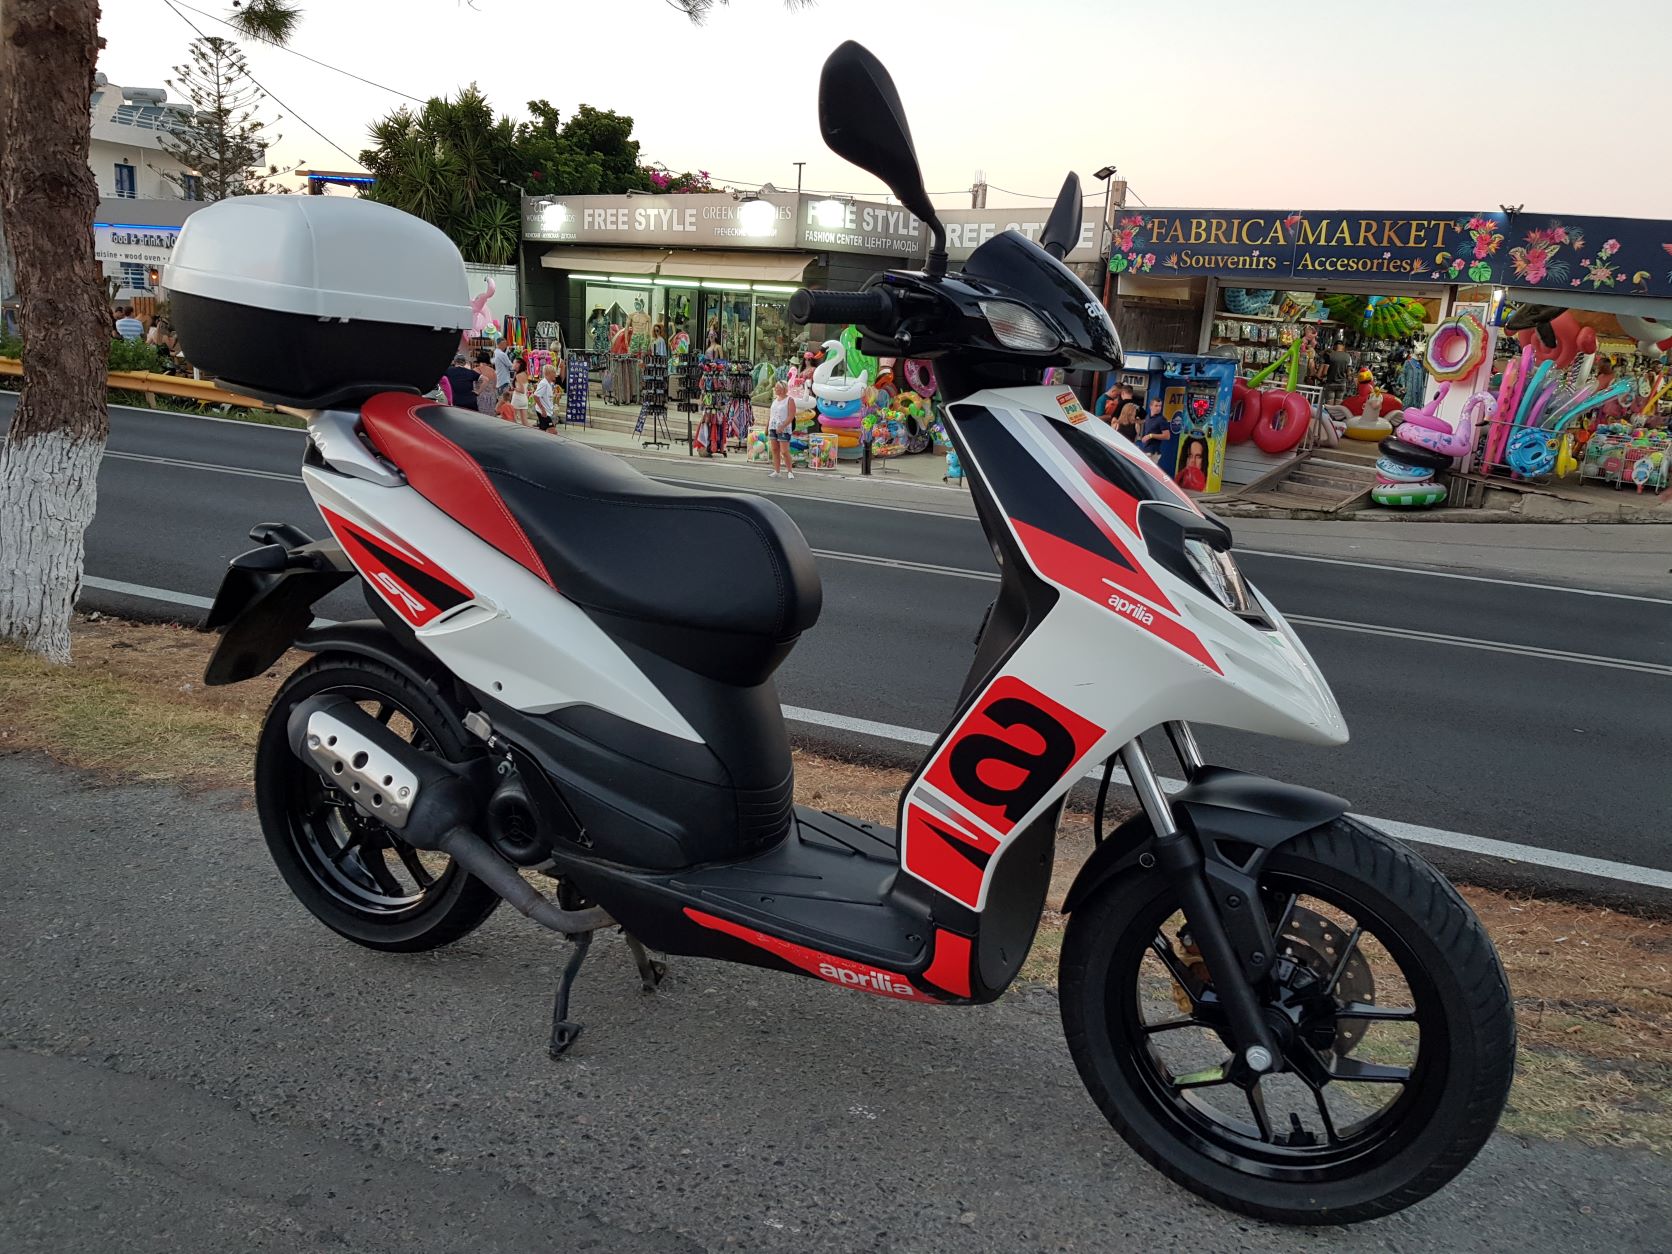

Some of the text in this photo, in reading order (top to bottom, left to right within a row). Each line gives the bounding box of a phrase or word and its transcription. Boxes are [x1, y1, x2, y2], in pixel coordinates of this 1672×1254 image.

[583, 208, 697, 231] FREE STYLE
[702, 206, 734, 219] GREEK
[807, 200, 857, 229] FE
[862, 207, 919, 236] STYLE
[805, 230, 863, 247] FASHION CENTER
[1150, 217, 1455, 248] FABRICA MARKET
[95, 250, 118, 259] uisine
[144, 254, 161, 262] oven
[864, 237, 919, 253] ЦЕНТР МОДЫ
[1180, 250, 1411, 274] Souvenirs Accesories
[1122, 375, 1144, 386] ATM
[1107, 594, 1155, 626] aprilia
[818, 962, 915, 996] aprilia
